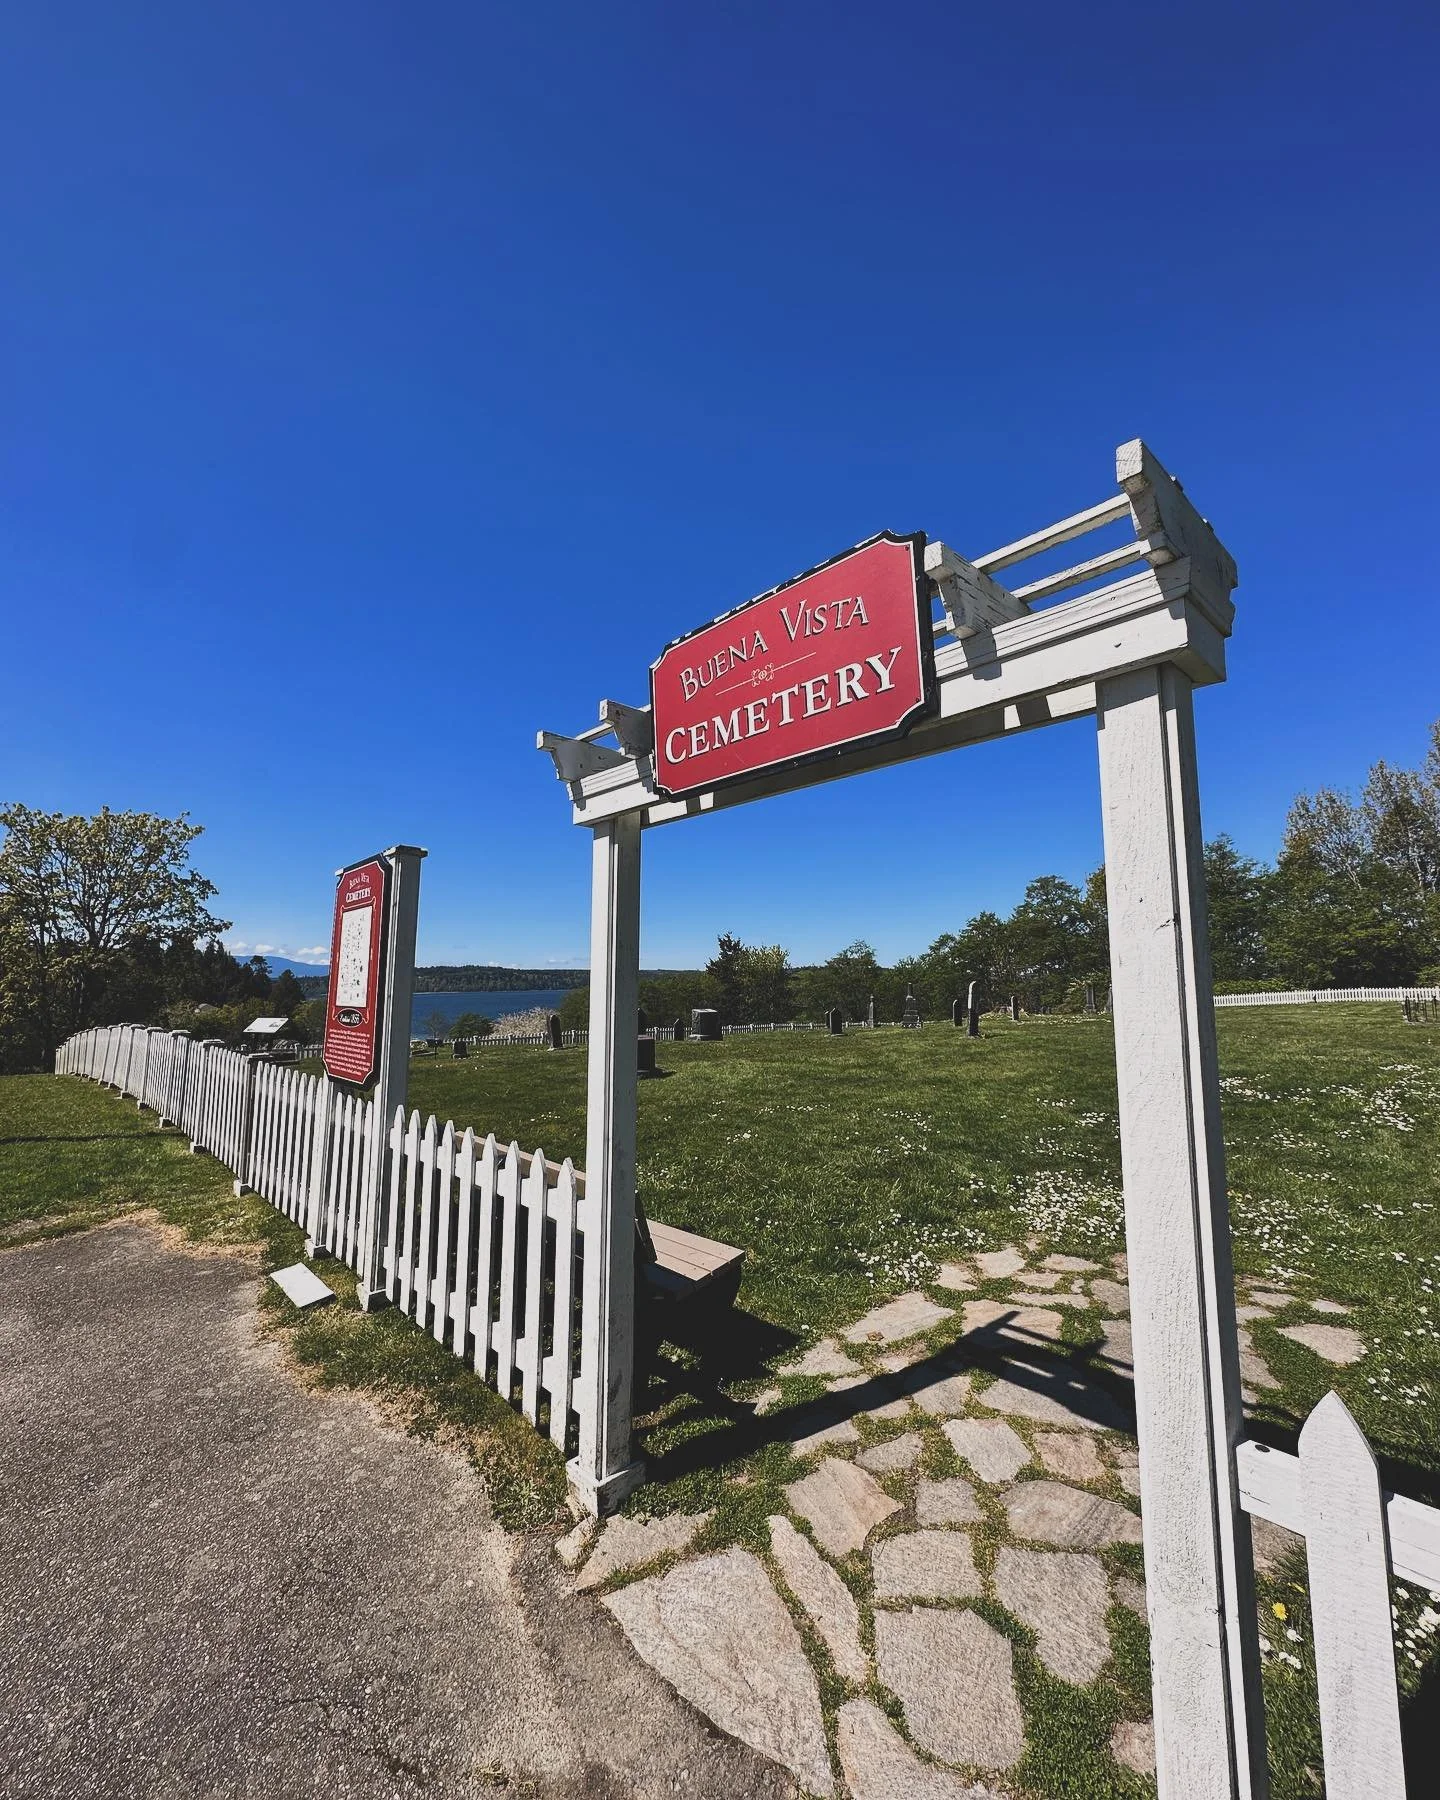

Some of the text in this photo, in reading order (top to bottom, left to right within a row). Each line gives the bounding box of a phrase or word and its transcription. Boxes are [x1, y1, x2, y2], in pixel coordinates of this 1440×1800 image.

[680, 597, 870, 701] BUENA VISTA
[665, 646, 902, 764] CEMETERY
